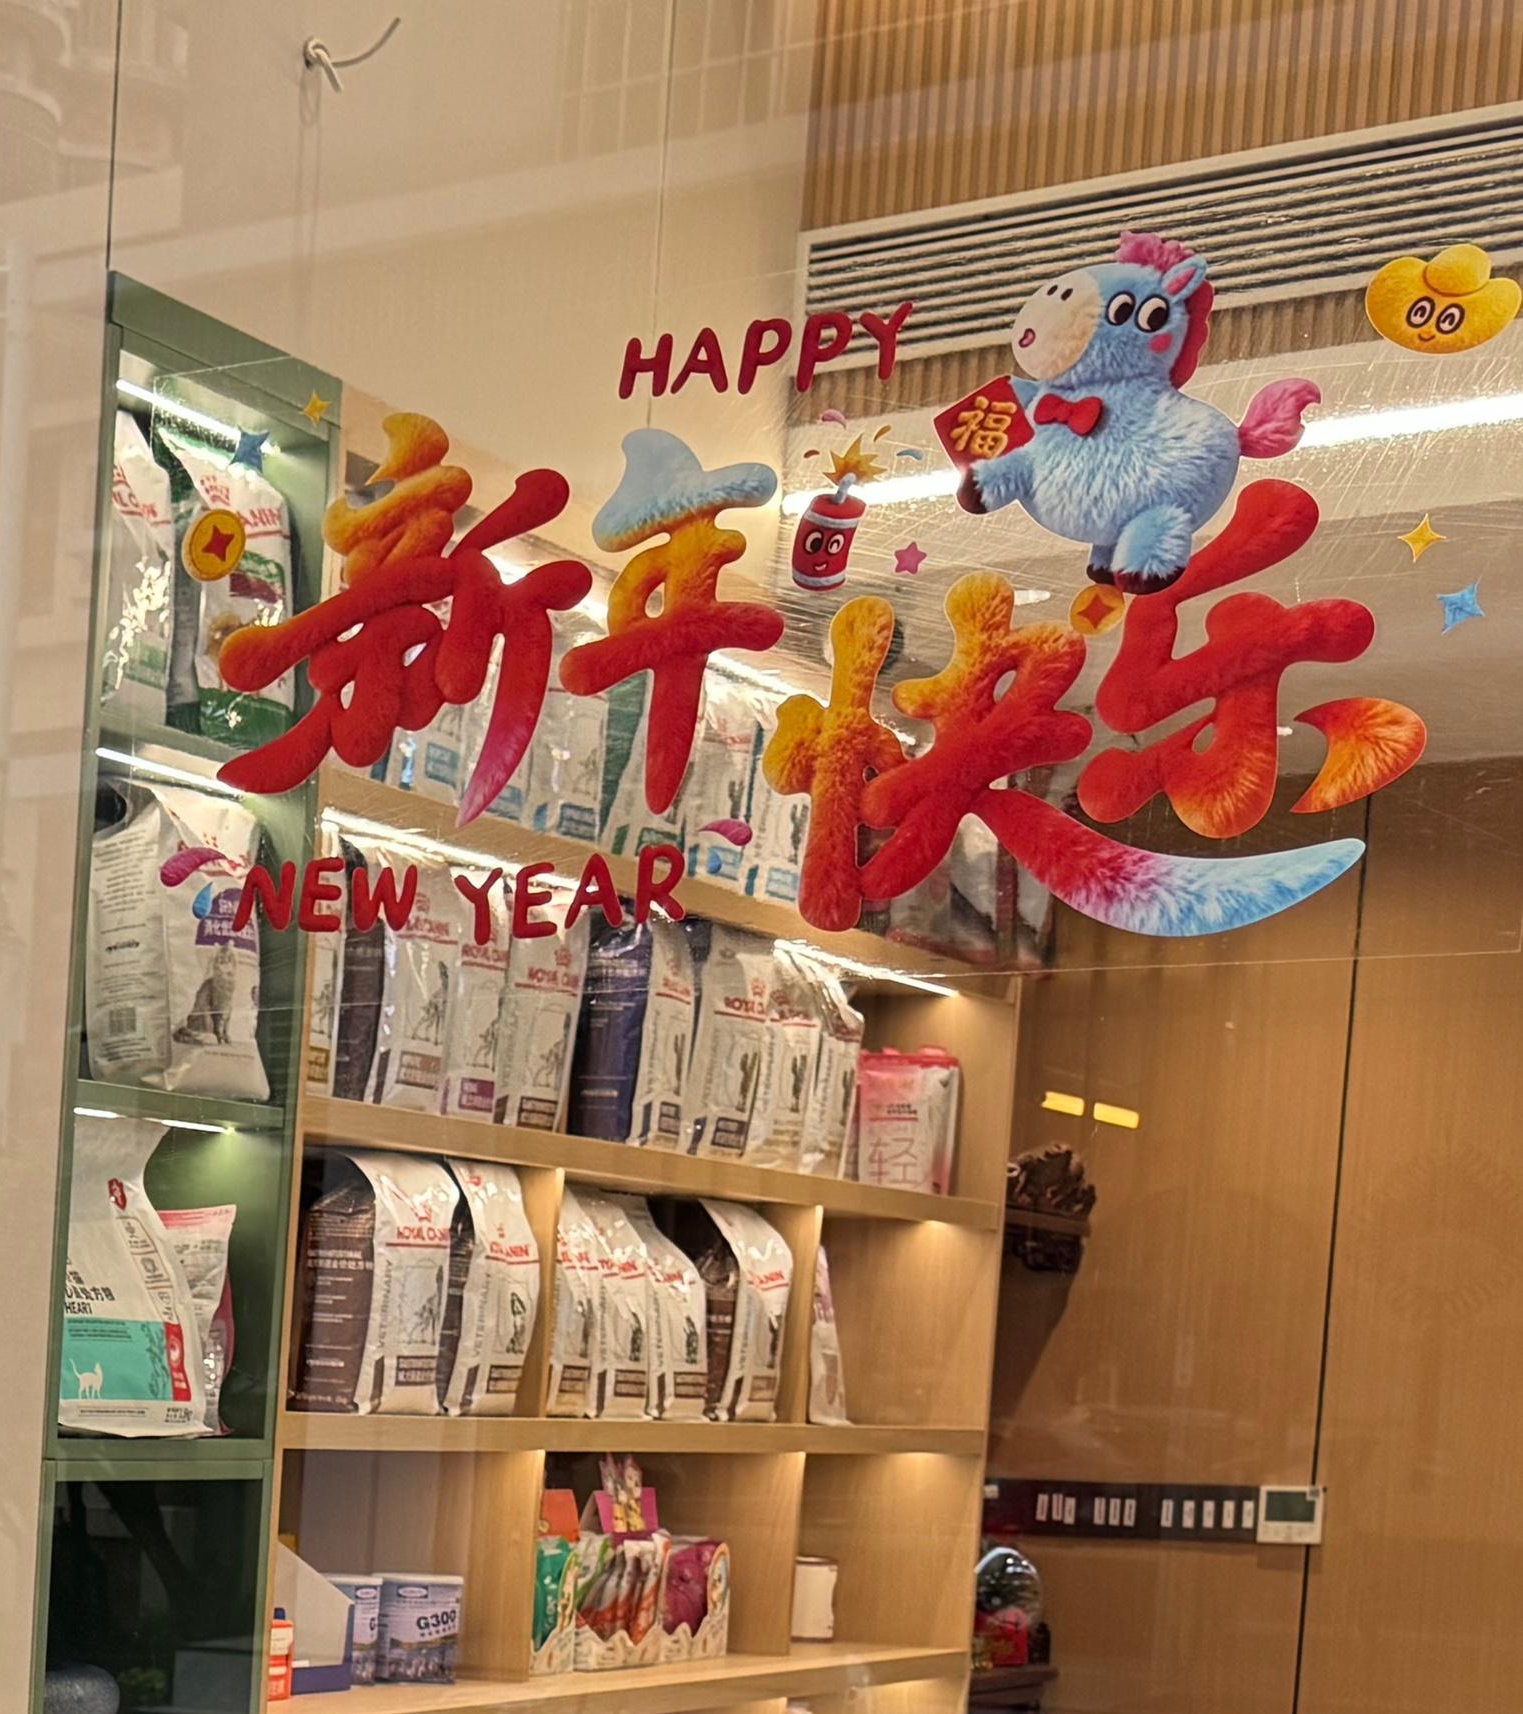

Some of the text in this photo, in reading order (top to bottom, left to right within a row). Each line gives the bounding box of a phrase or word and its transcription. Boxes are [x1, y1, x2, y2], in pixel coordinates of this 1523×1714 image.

[619, 302, 914, 399] HAPPY
[954, 395, 1014, 461] 福
[231, 857, 418, 934] NEW
[455, 844, 685, 945] YEAR
[64, 1301, 93, 1315] HEART
[416, 1609, 458, 1632] G300
